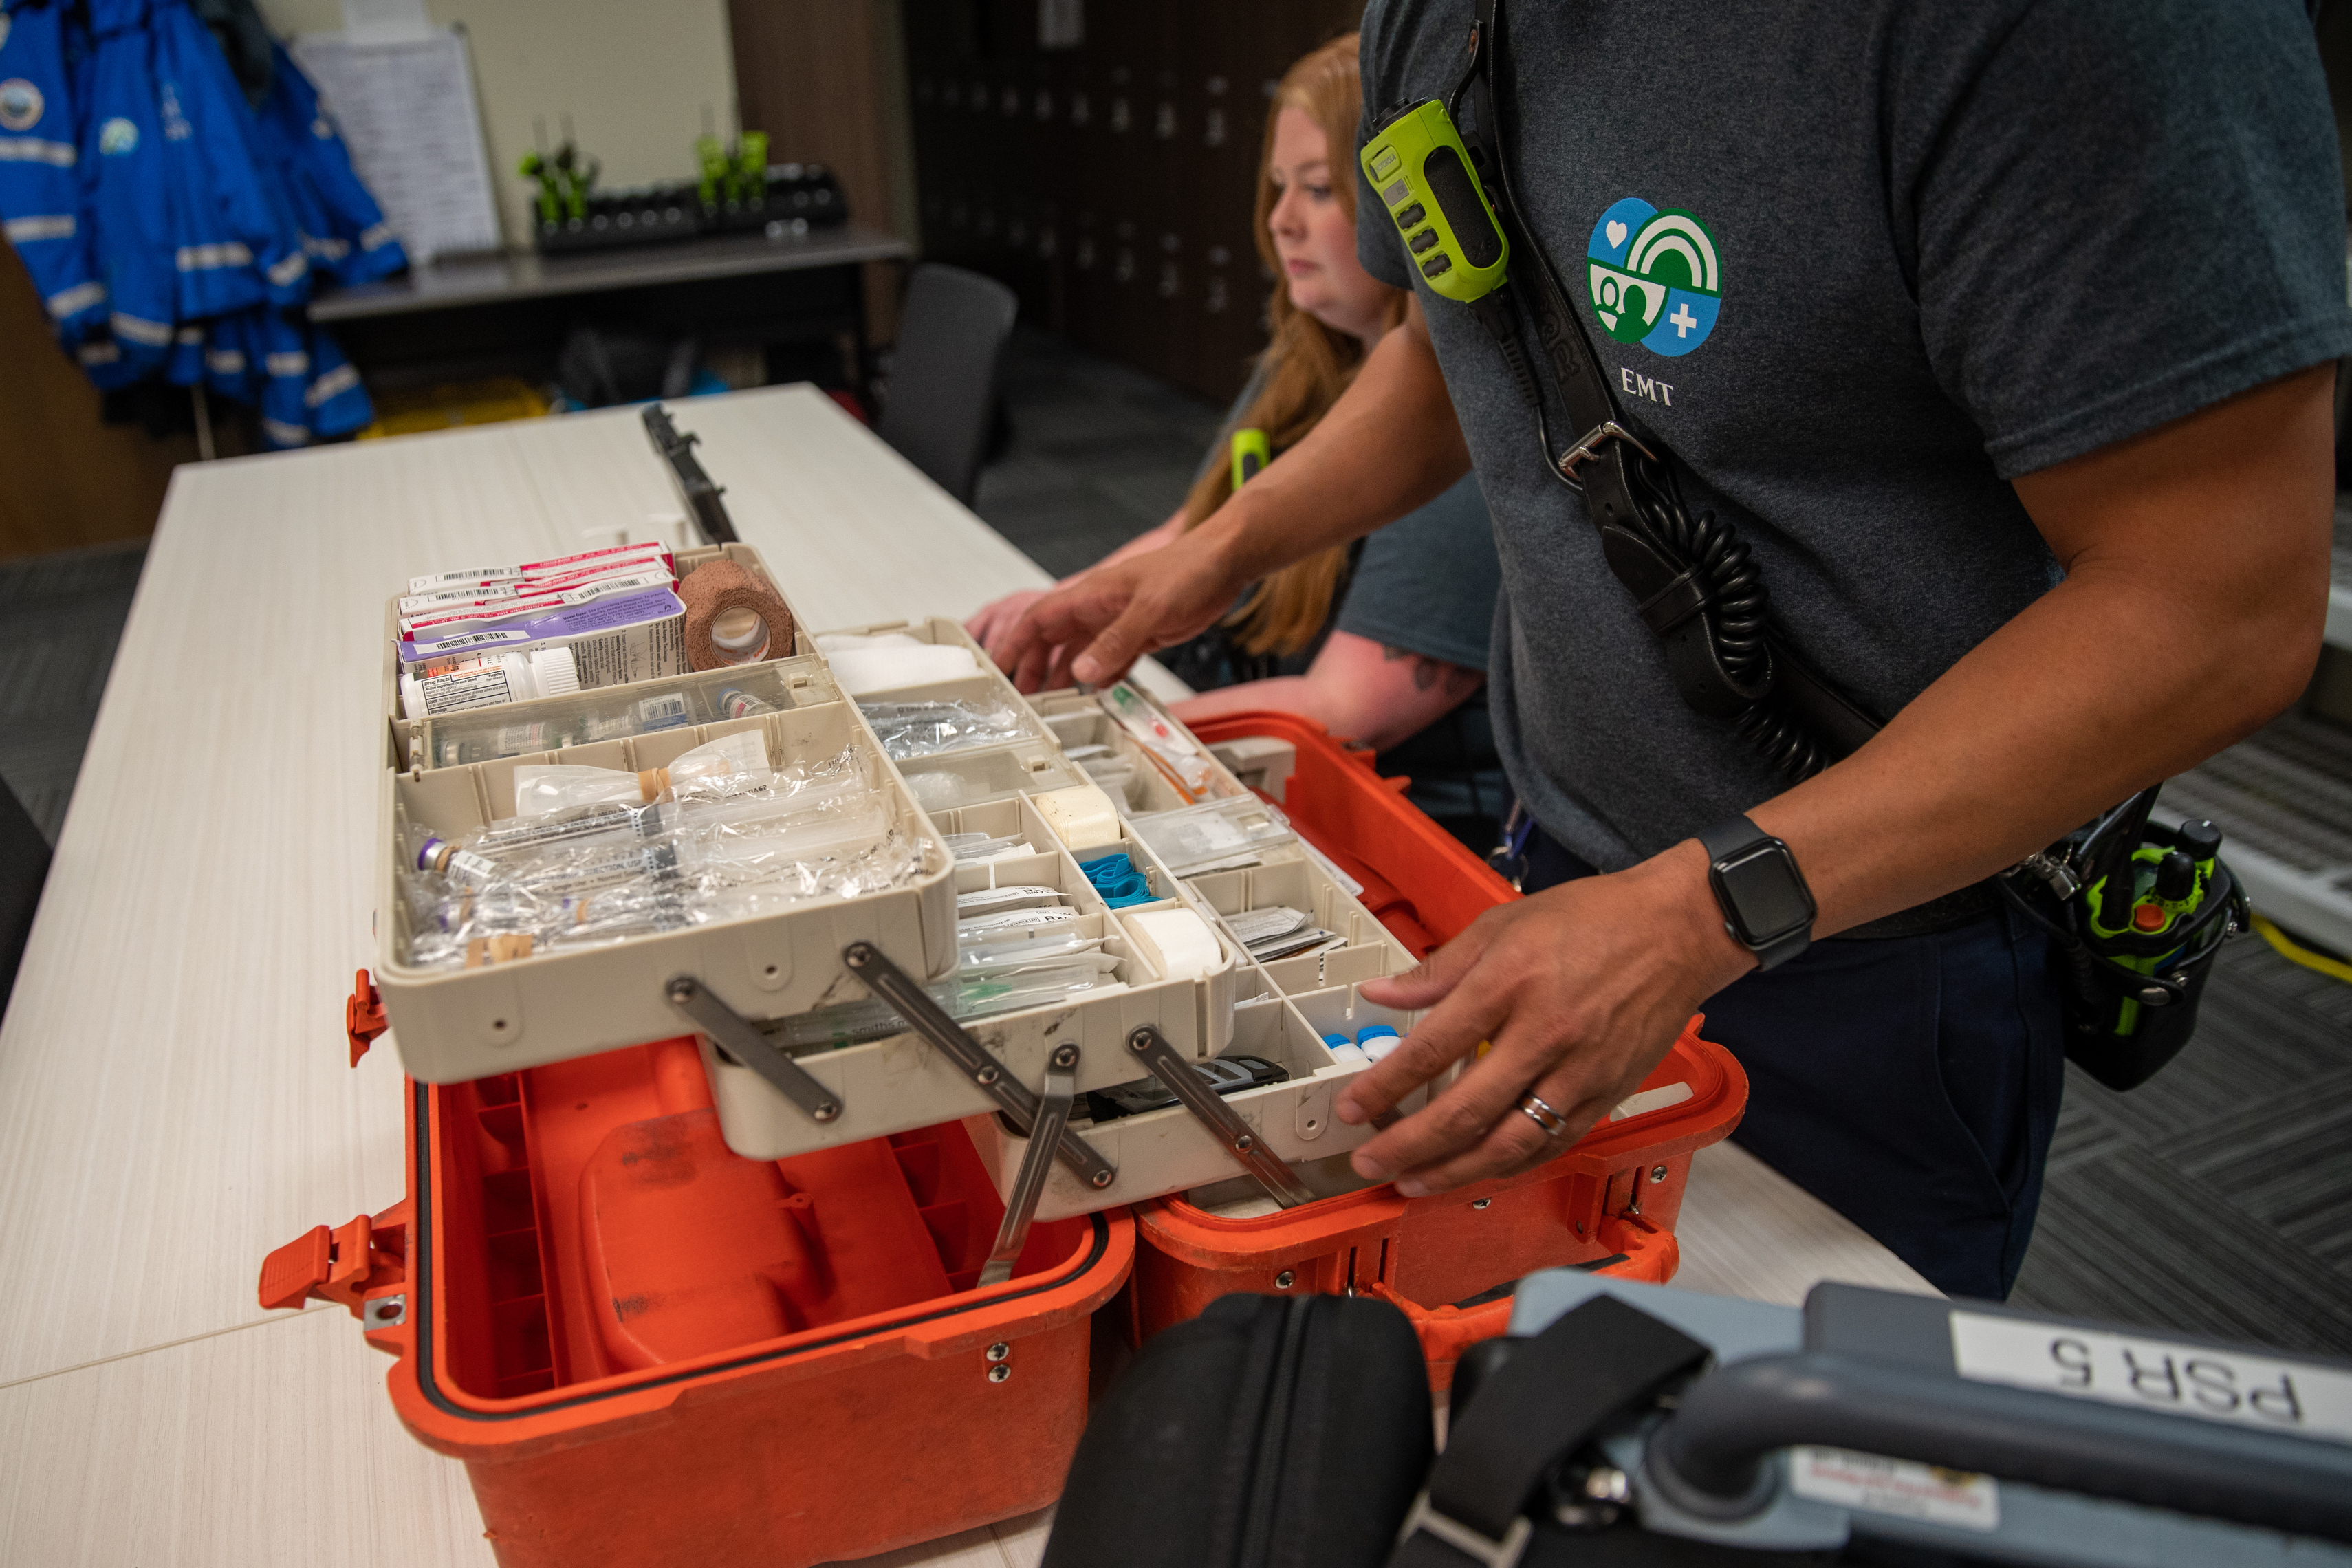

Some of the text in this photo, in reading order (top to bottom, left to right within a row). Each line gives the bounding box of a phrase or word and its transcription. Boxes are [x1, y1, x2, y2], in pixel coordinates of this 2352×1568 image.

[1375, 153, 1396, 173] MOTOROLA
[1621, 367, 1673, 406] EMT
[445, 686, 470, 694] anti-inflammatory
[851, 1021, 893, 1033] smiths
[2051, 1338, 2304, 1424] PSR 5
